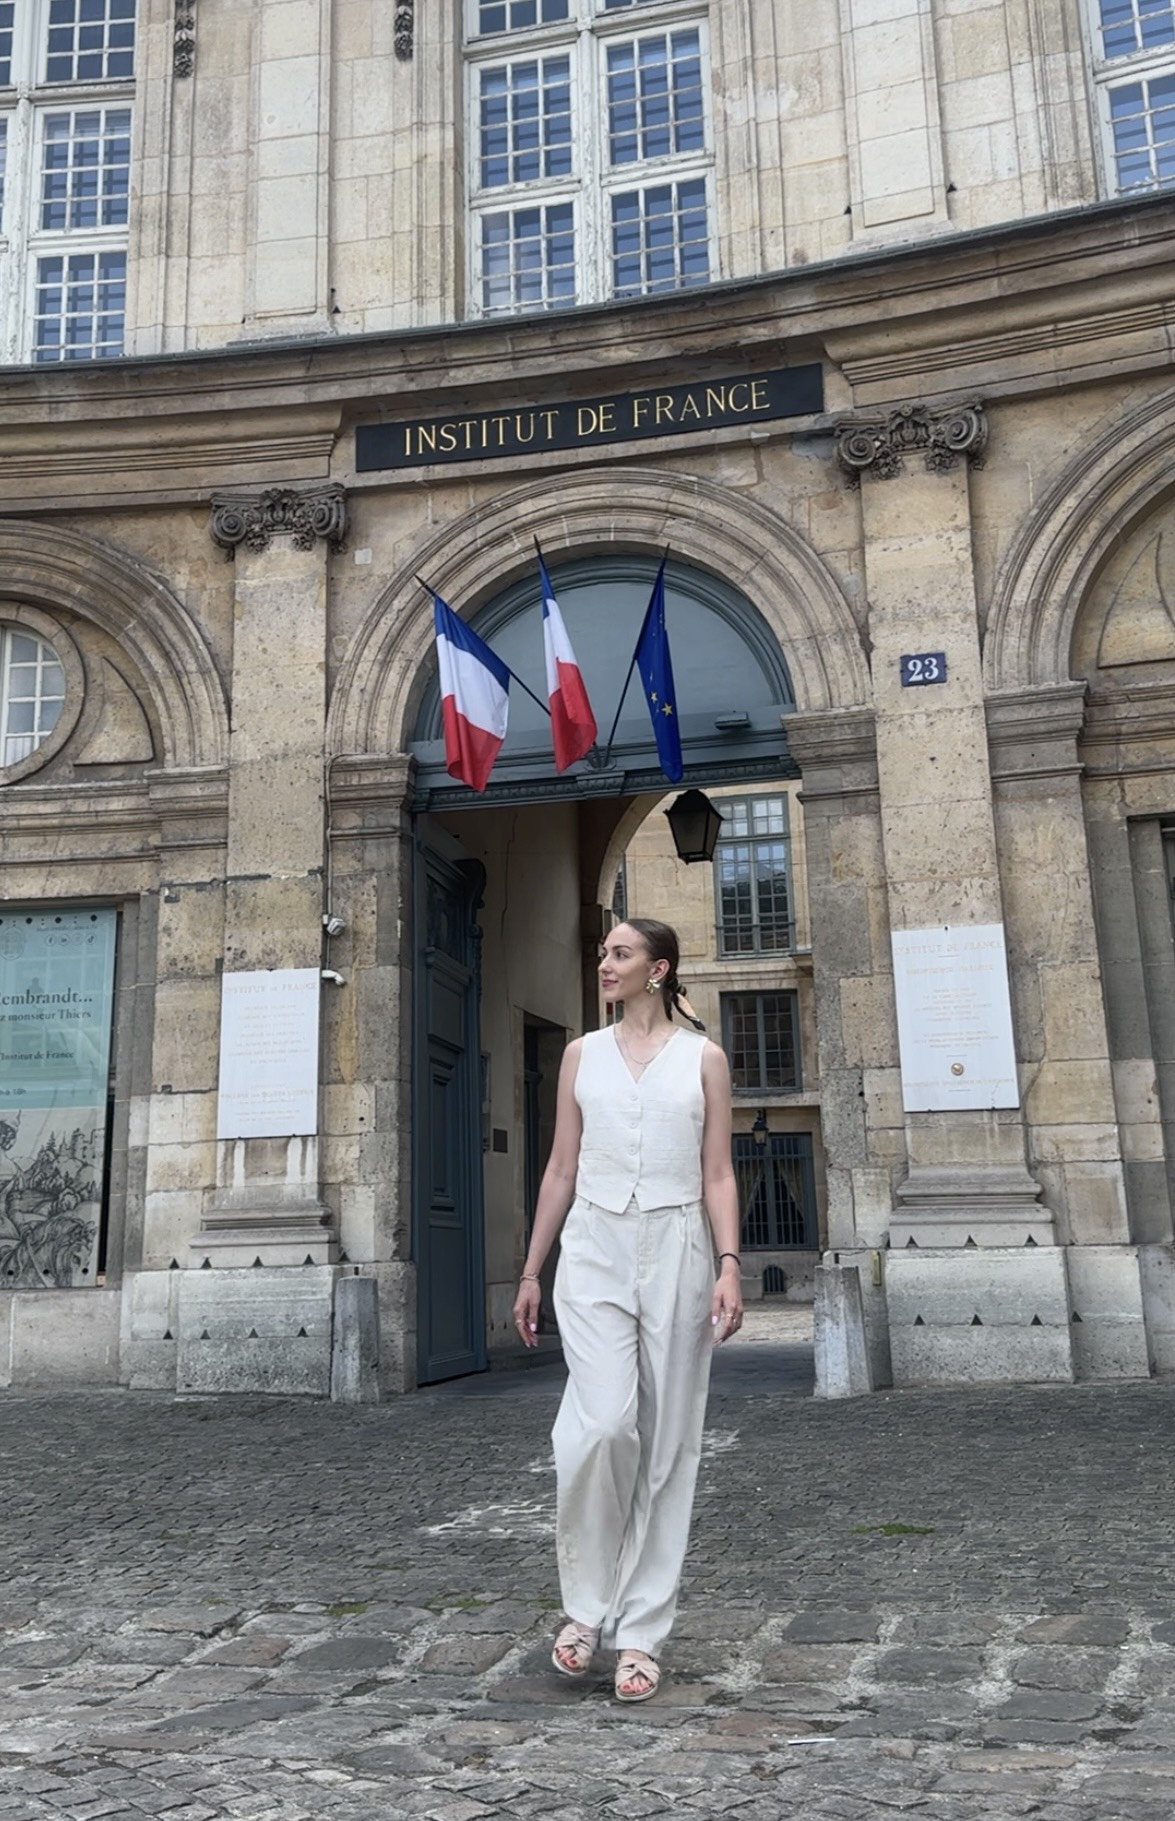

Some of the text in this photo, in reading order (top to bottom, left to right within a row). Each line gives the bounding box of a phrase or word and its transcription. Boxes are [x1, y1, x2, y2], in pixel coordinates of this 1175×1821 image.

[404, 379, 771, 456] INSTITUT DE FRANCE
[907, 657, 939, 682] 23
[0, 987, 93, 1005] embrandt...
[8, 1011, 56, 1021] monsieur
[57, 1008, 92, 1020] Thiers
[46, 1050, 75, 1060] France
